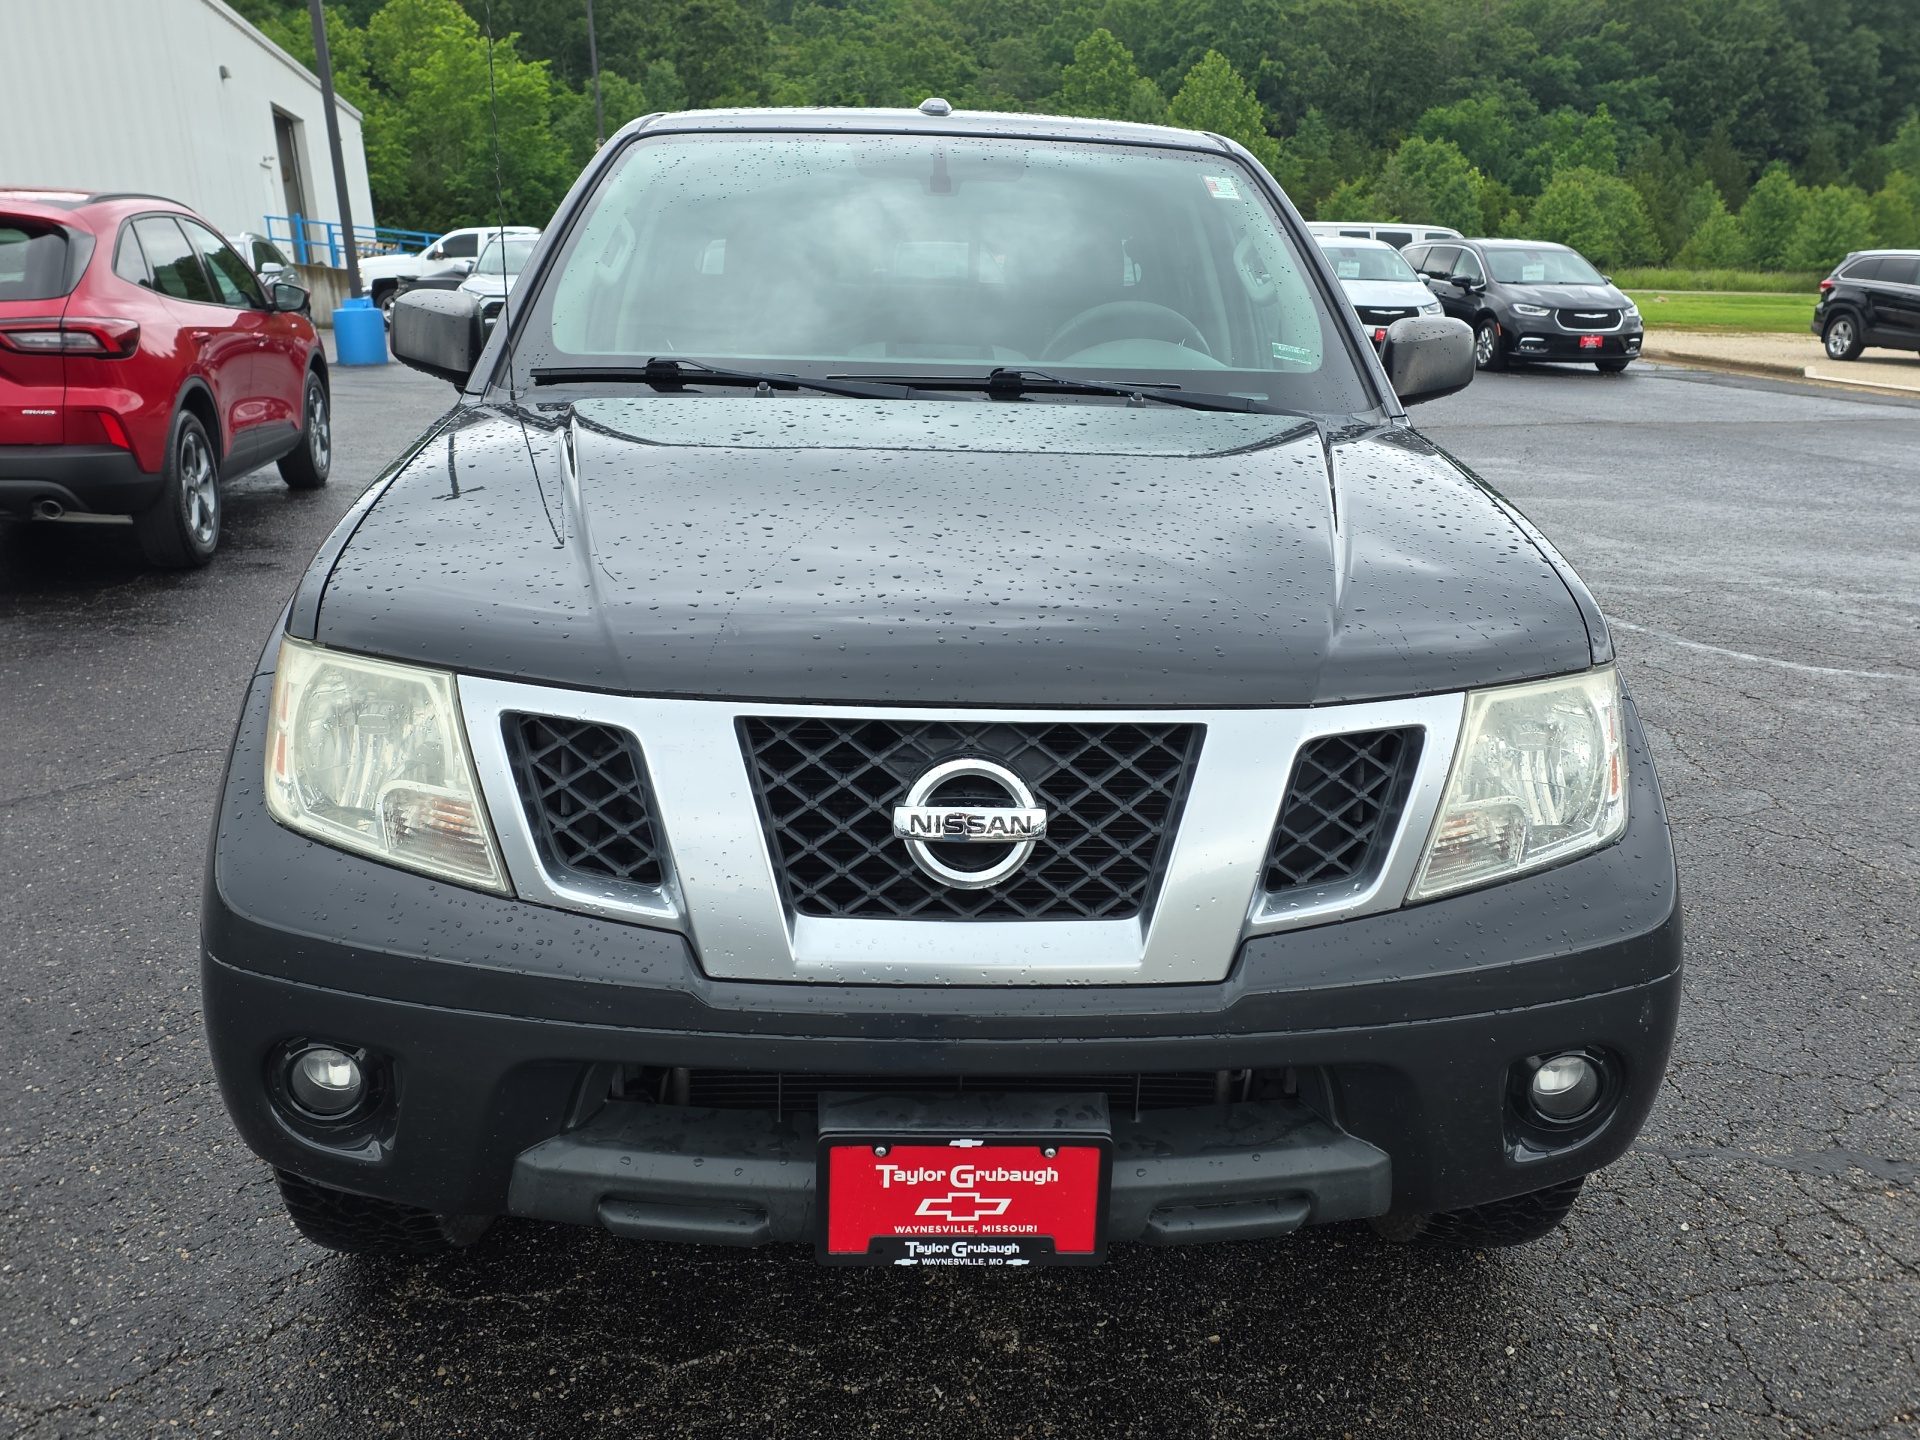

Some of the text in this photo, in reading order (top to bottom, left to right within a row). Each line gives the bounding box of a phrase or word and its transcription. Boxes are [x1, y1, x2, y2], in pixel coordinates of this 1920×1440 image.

[910, 813, 1032, 835] NISSAN
[875, 1164, 1059, 1188] Taylor Grubaugh
[894, 1224, 1038, 1234] WAYNESVILLE, MISSOURI
[904, 1241, 1020, 1257] Taylor Grubaugh
[921, 1257, 1004, 1267] WAYNESVILLE, MO
